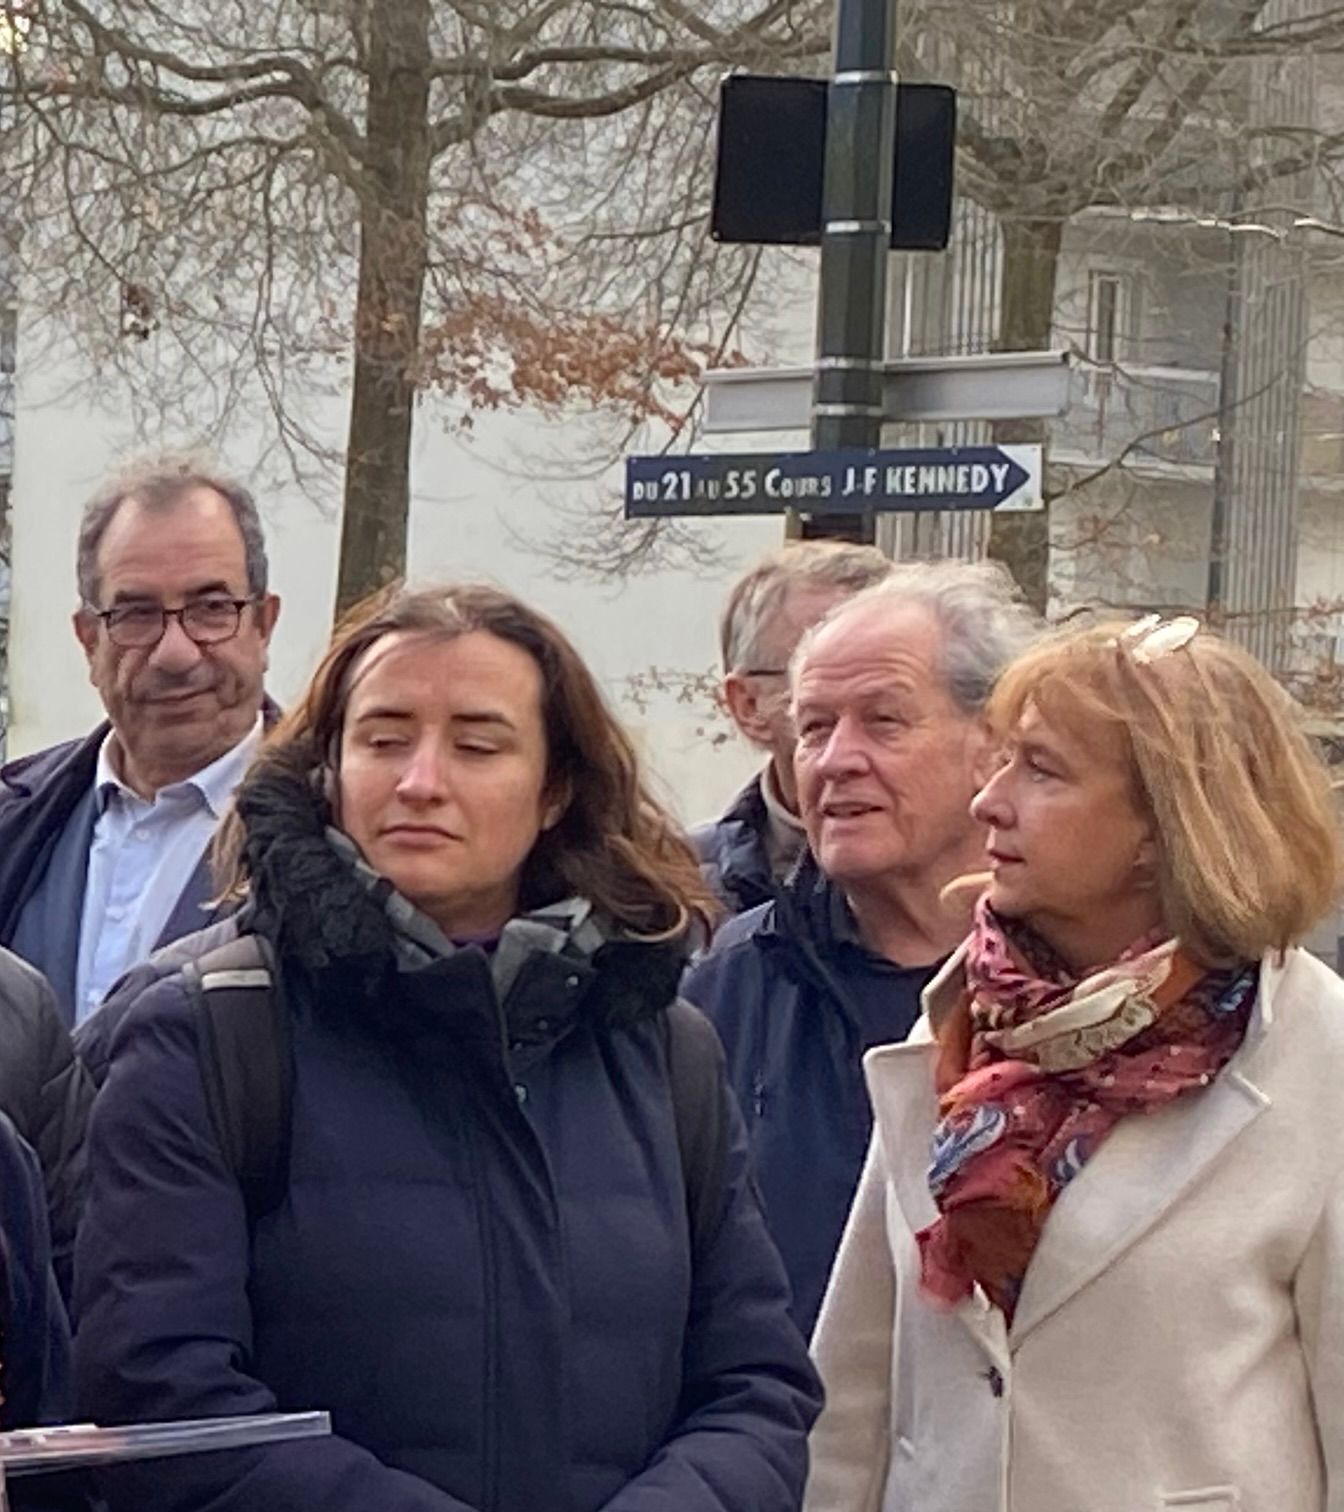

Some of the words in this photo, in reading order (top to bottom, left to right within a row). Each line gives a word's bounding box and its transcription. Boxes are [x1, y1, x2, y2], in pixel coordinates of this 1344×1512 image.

[632, 480, 659, 500] DU
[662, 471, 691, 500] 21
[724, 470, 757, 499] 55
[885, 463, 1010, 494] KENNEDY
